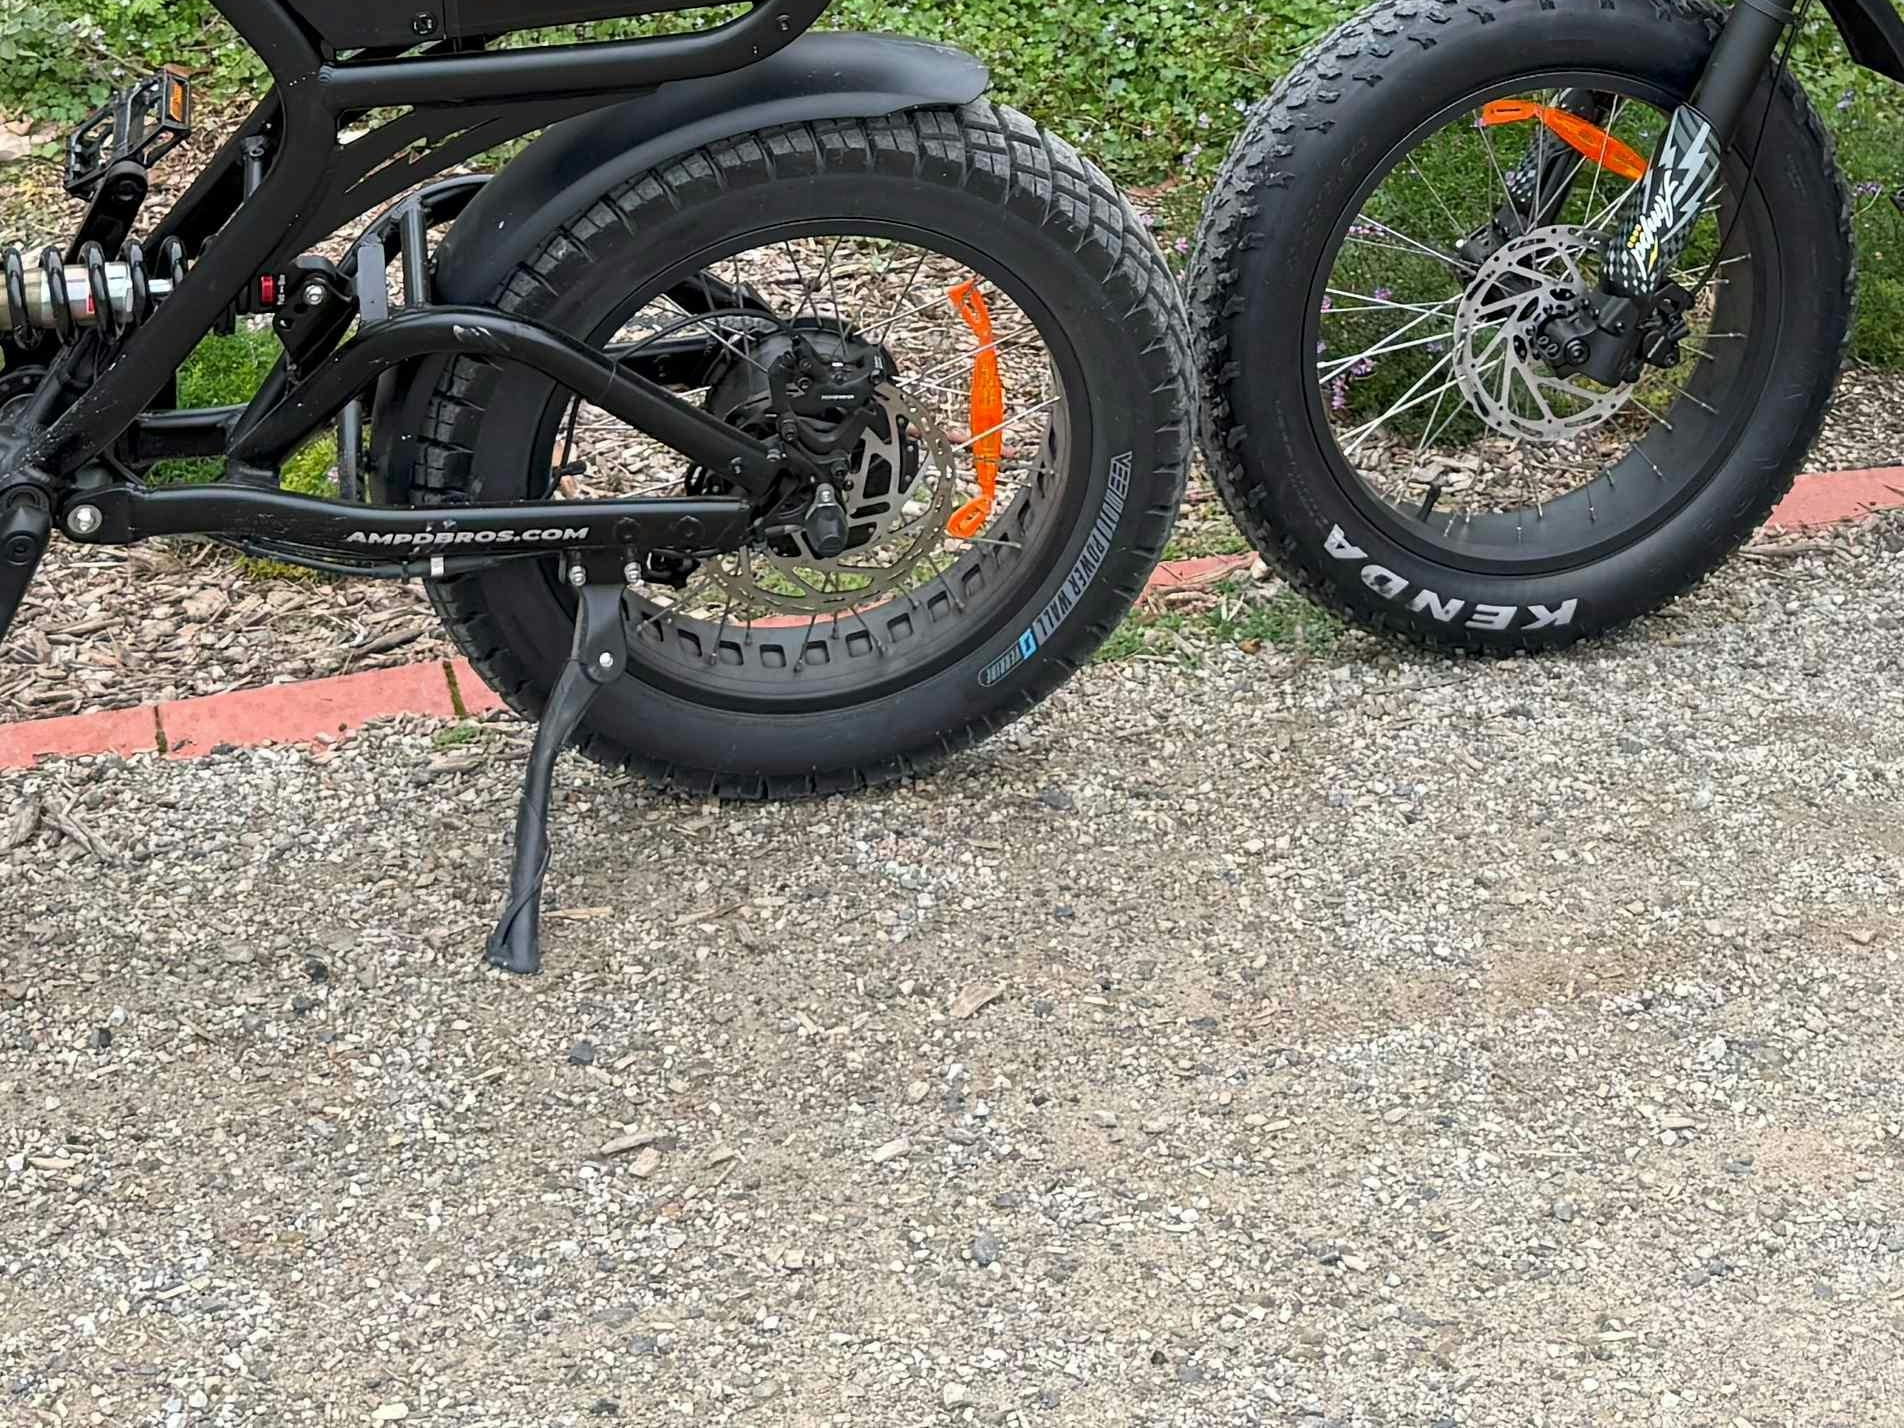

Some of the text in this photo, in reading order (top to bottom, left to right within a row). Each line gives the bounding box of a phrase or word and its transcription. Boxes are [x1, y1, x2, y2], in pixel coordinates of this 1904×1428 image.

[346, 527, 590, 545] AMPDBROS.COM
[1067, 531, 1109, 596] POWER
[1323, 523, 1578, 630] KENDA
[1035, 590, 1073, 635] WALL
